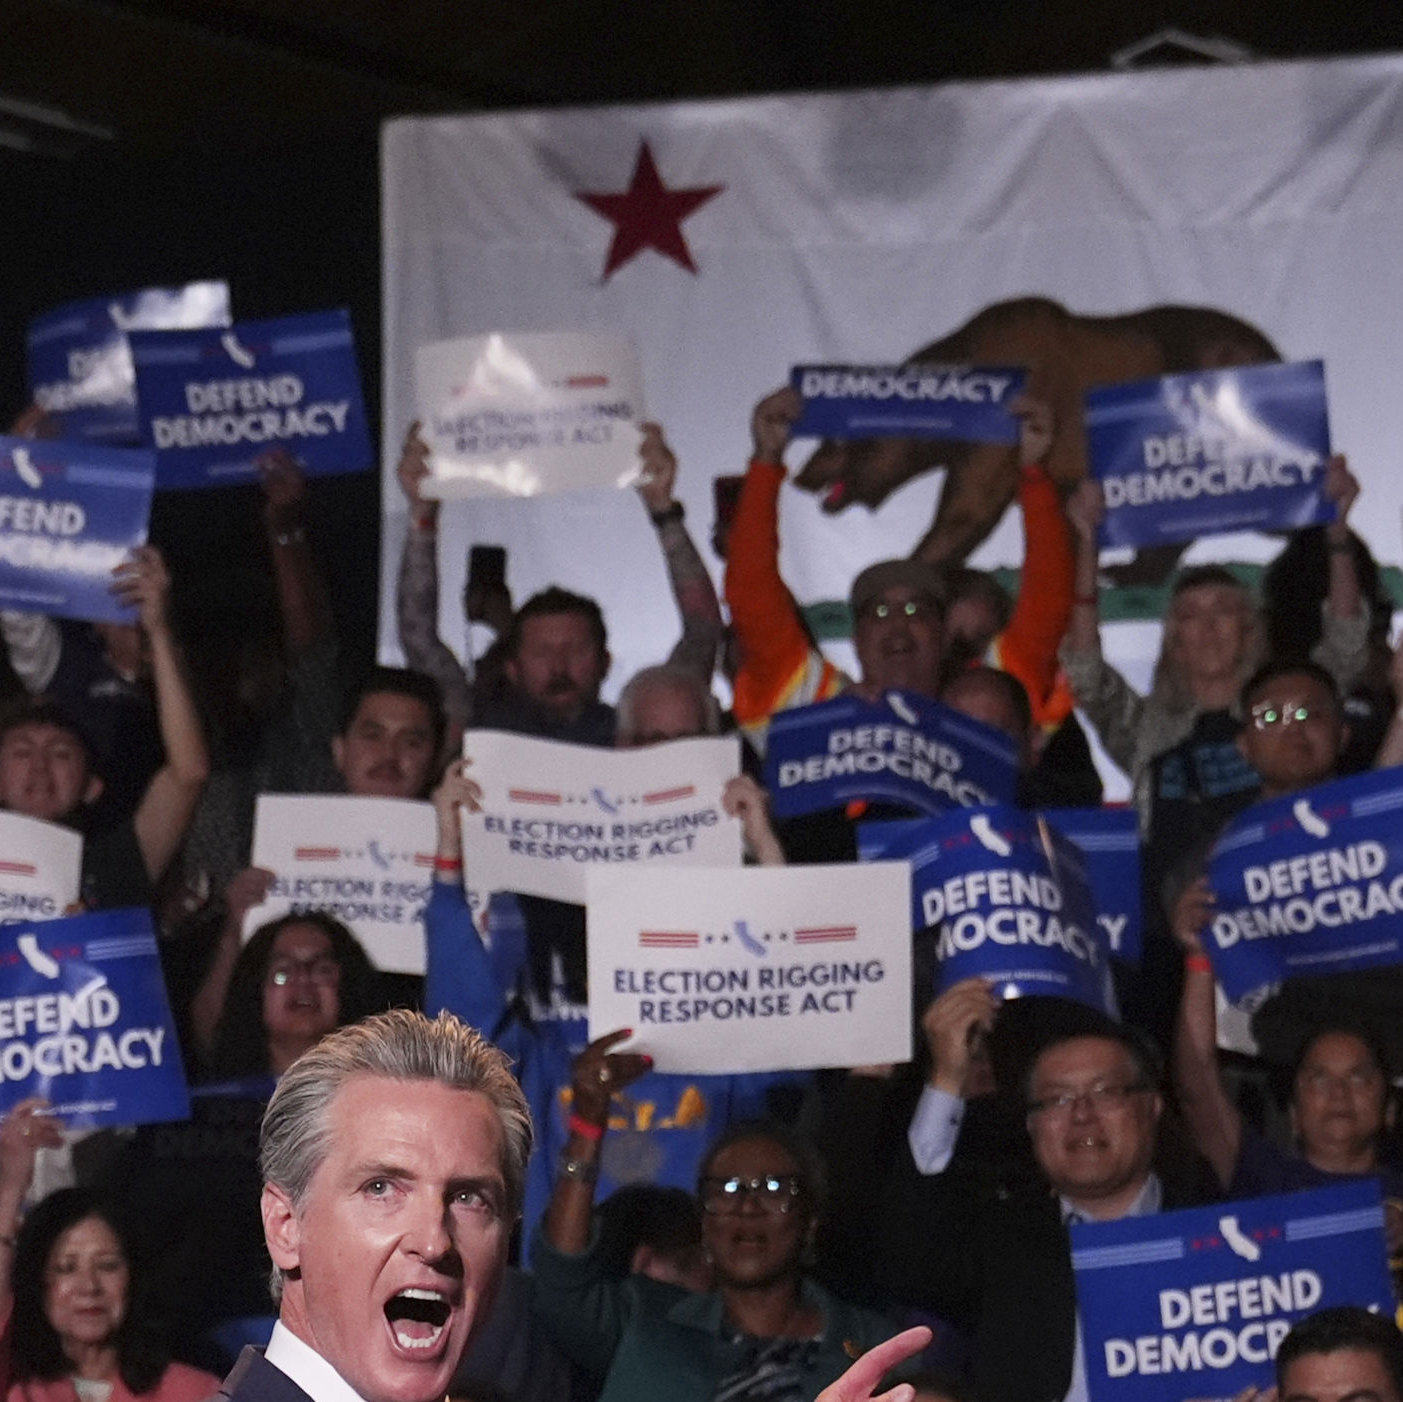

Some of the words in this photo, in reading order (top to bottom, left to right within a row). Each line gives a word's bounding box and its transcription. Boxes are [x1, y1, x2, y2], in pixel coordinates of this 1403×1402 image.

[185, 376, 303, 413] DEFEND
[802, 370, 1011, 403] DEMOCRACY
[151, 403, 352, 450] DEMOCRACY
[1103, 453, 1320, 509] DEMOCRACY
[828, 724, 963, 774] DEFEND
[778, 750, 997, 808] DEMOCRAC
[484, 815, 605, 841] ELECTION
[610, 809, 719, 840] RIGGING
[508, 836, 642, 864] RESPONSE
[650, 834, 697, 857] ACT
[1243, 840, 1388, 902] DEFEND
[921, 868, 1064, 928] DEFEND
[613, 968, 749, 995] ELECTION
[758, 960, 885, 991] RIGGING
[639, 996, 793, 1024] RESPONSE
[799, 988, 858, 1015] ACT
[1158, 1270, 1322, 1330] DEFEND
[1103, 1319, 1291, 1379] DEMOCR
